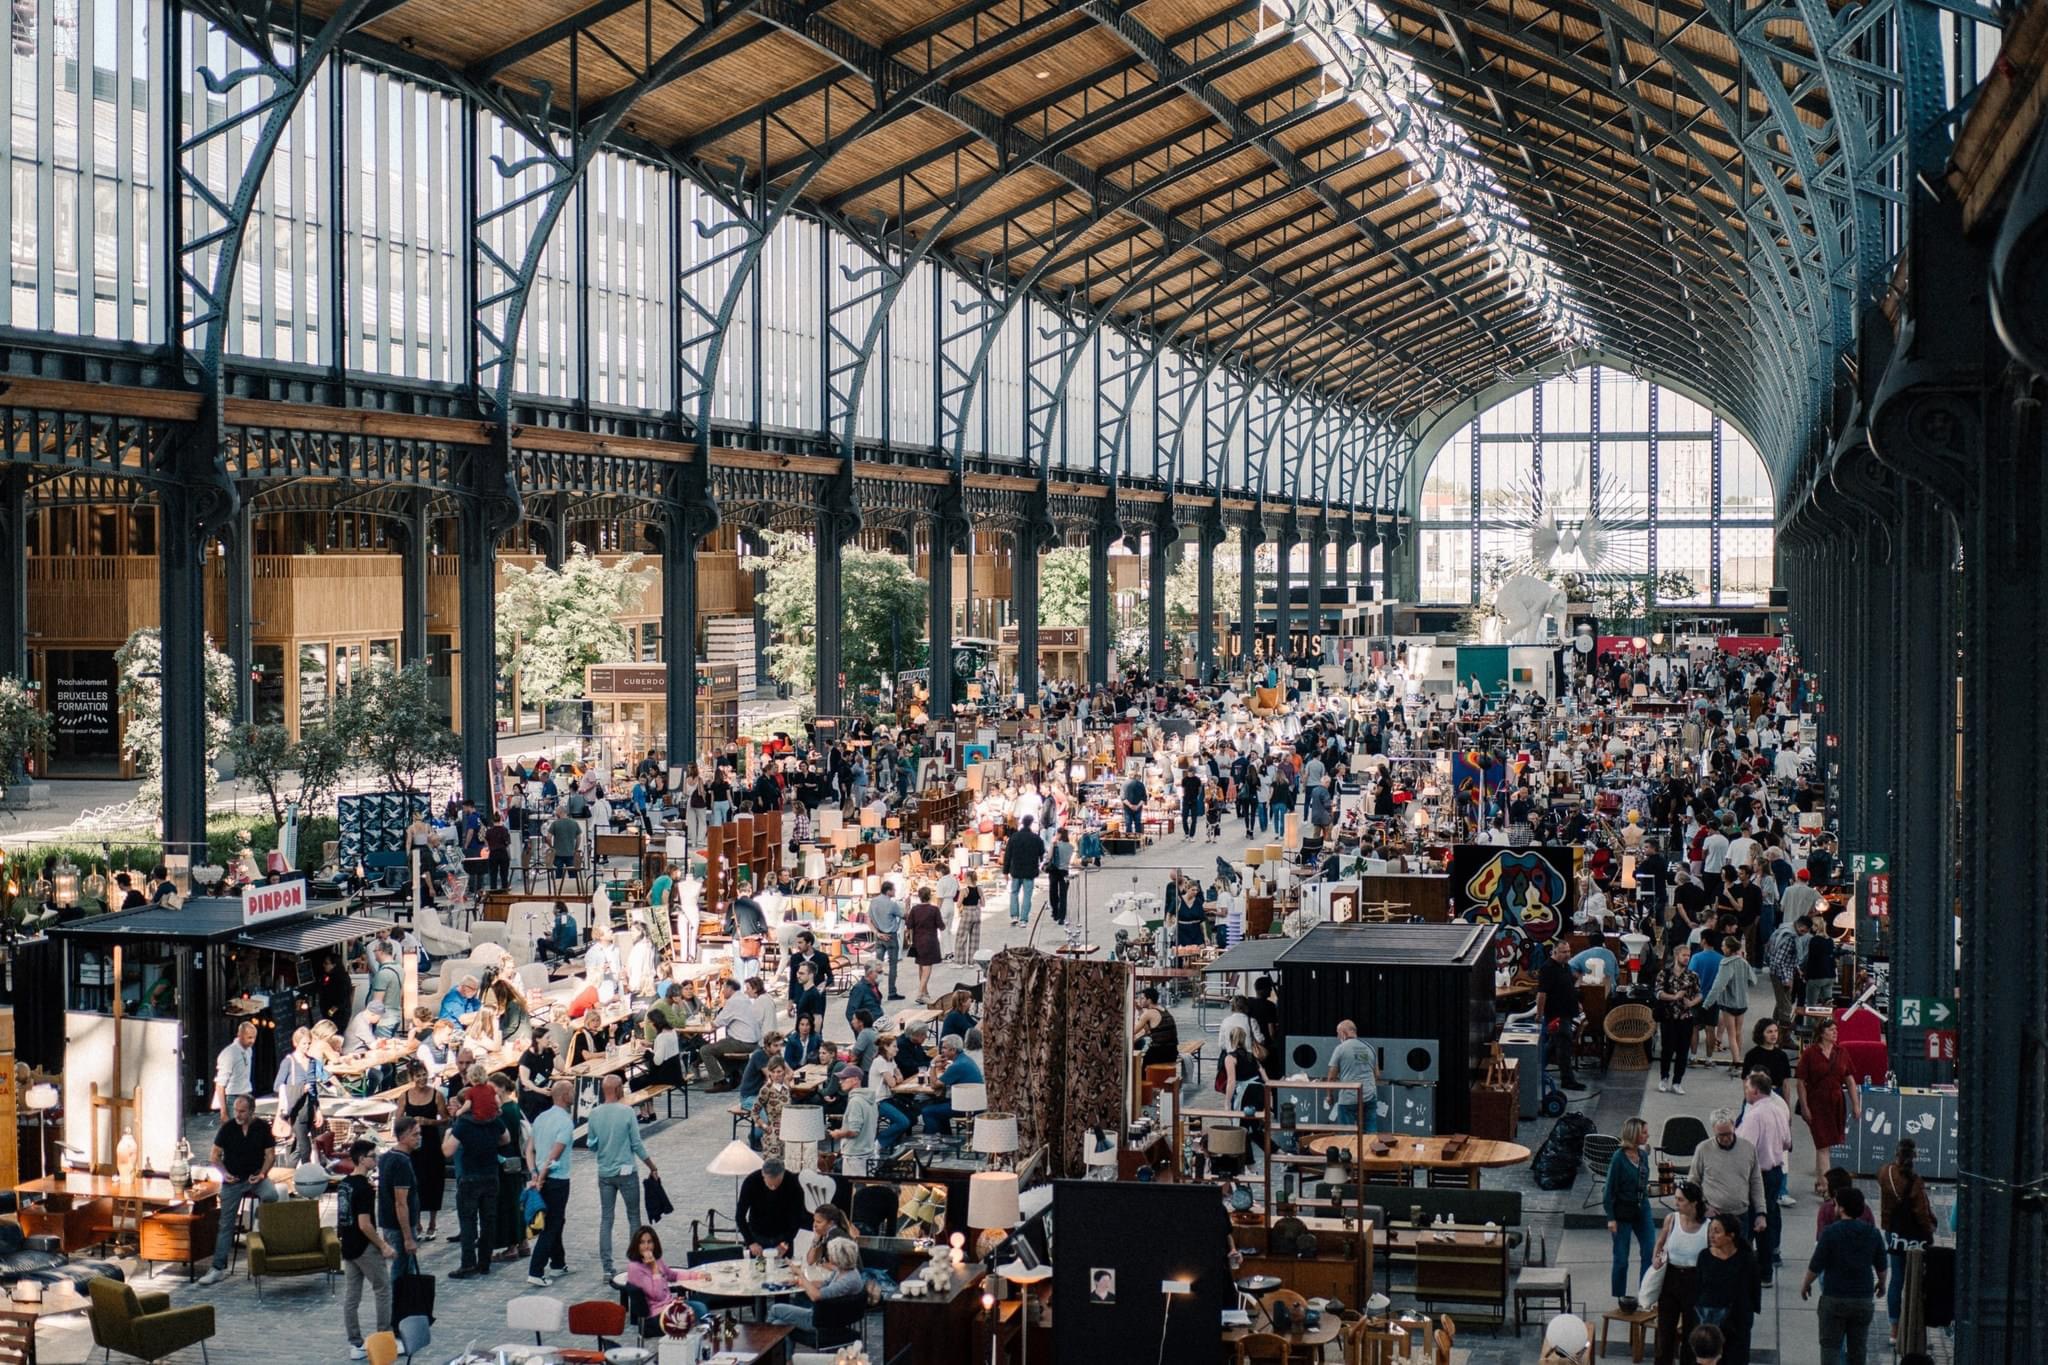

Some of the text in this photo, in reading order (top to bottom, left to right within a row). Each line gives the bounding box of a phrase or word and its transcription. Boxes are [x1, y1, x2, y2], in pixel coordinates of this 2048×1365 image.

[57, 678, 108, 686] Prochainement
[623, 678, 665, 686] CUBERDO
[57, 692, 109, 701] BRUXELLES
[57, 702, 109, 711] FORMATION
[248, 886, 301, 916] PINPON
